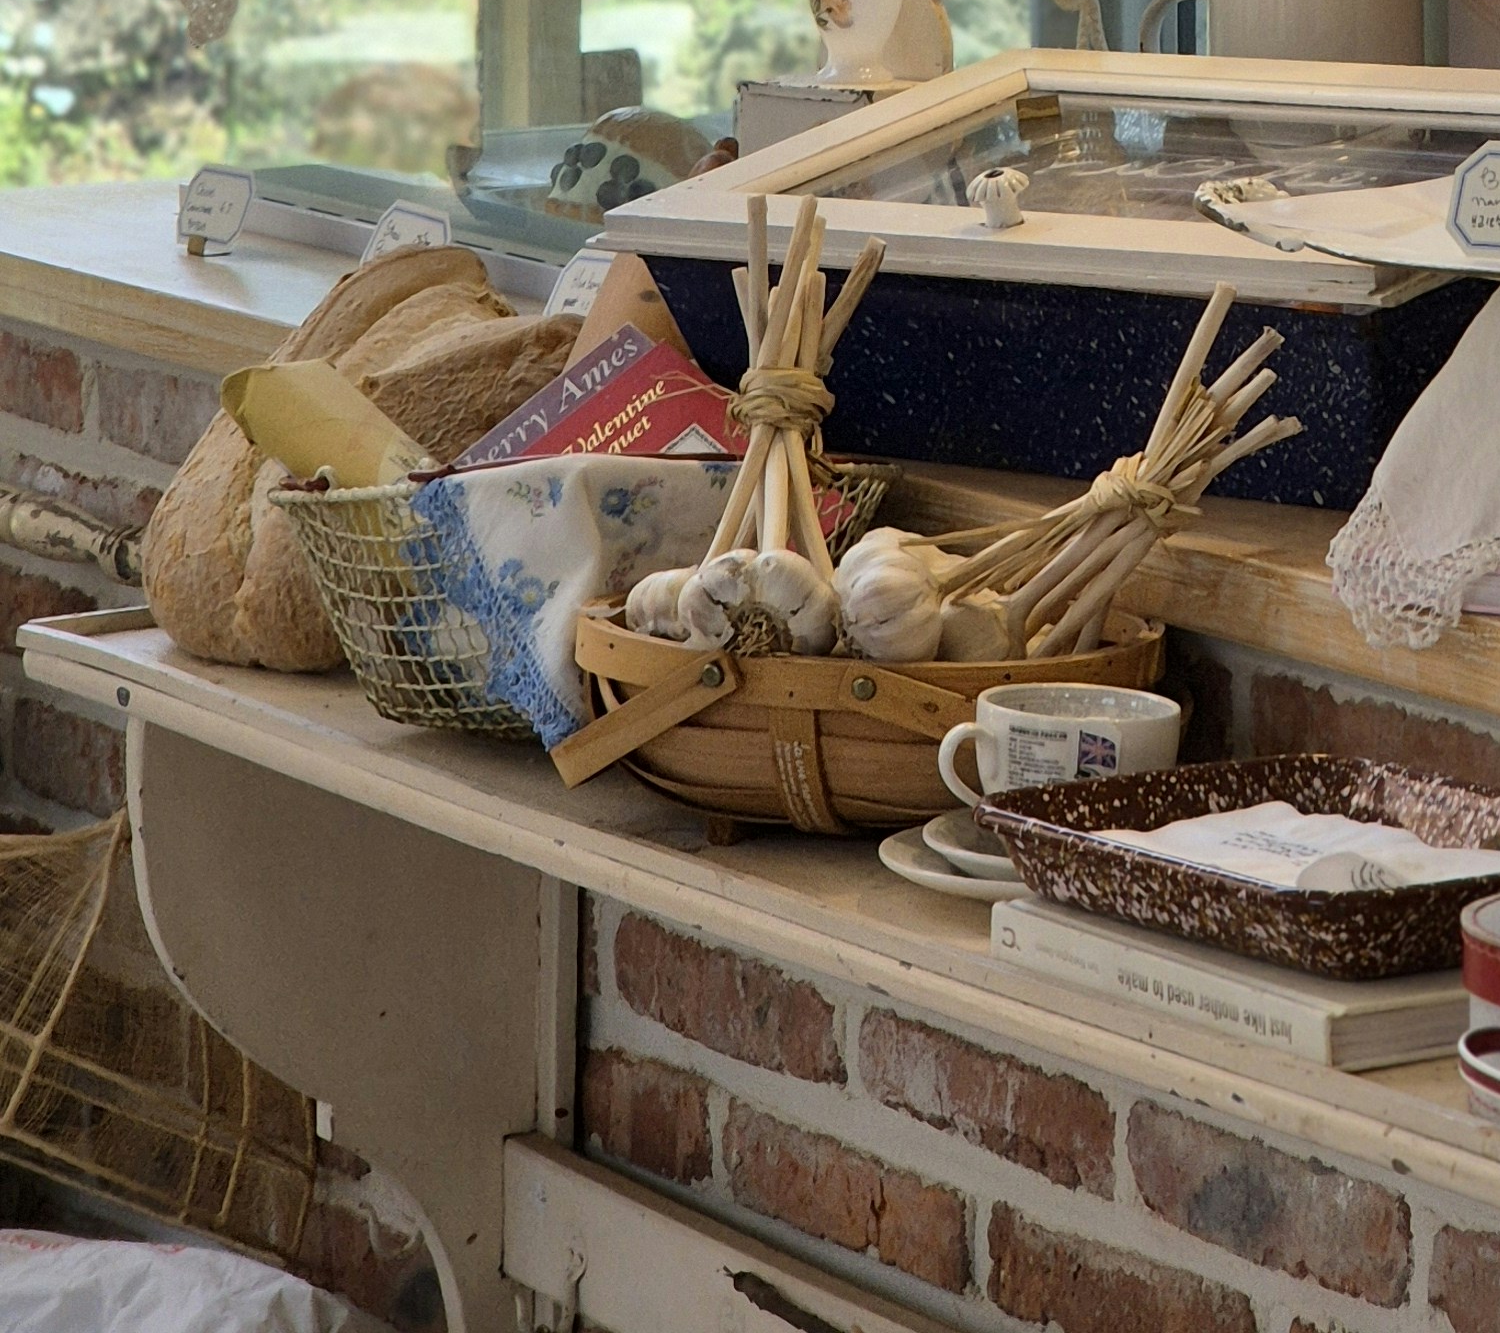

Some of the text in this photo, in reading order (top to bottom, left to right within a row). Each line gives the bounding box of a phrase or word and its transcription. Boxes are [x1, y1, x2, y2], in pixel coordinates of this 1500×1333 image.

[463, 337, 639, 467] herry Ames
[606, 414, 653, 454] quet
[1117, 967, 1293, 1045] Just like mother used to make
